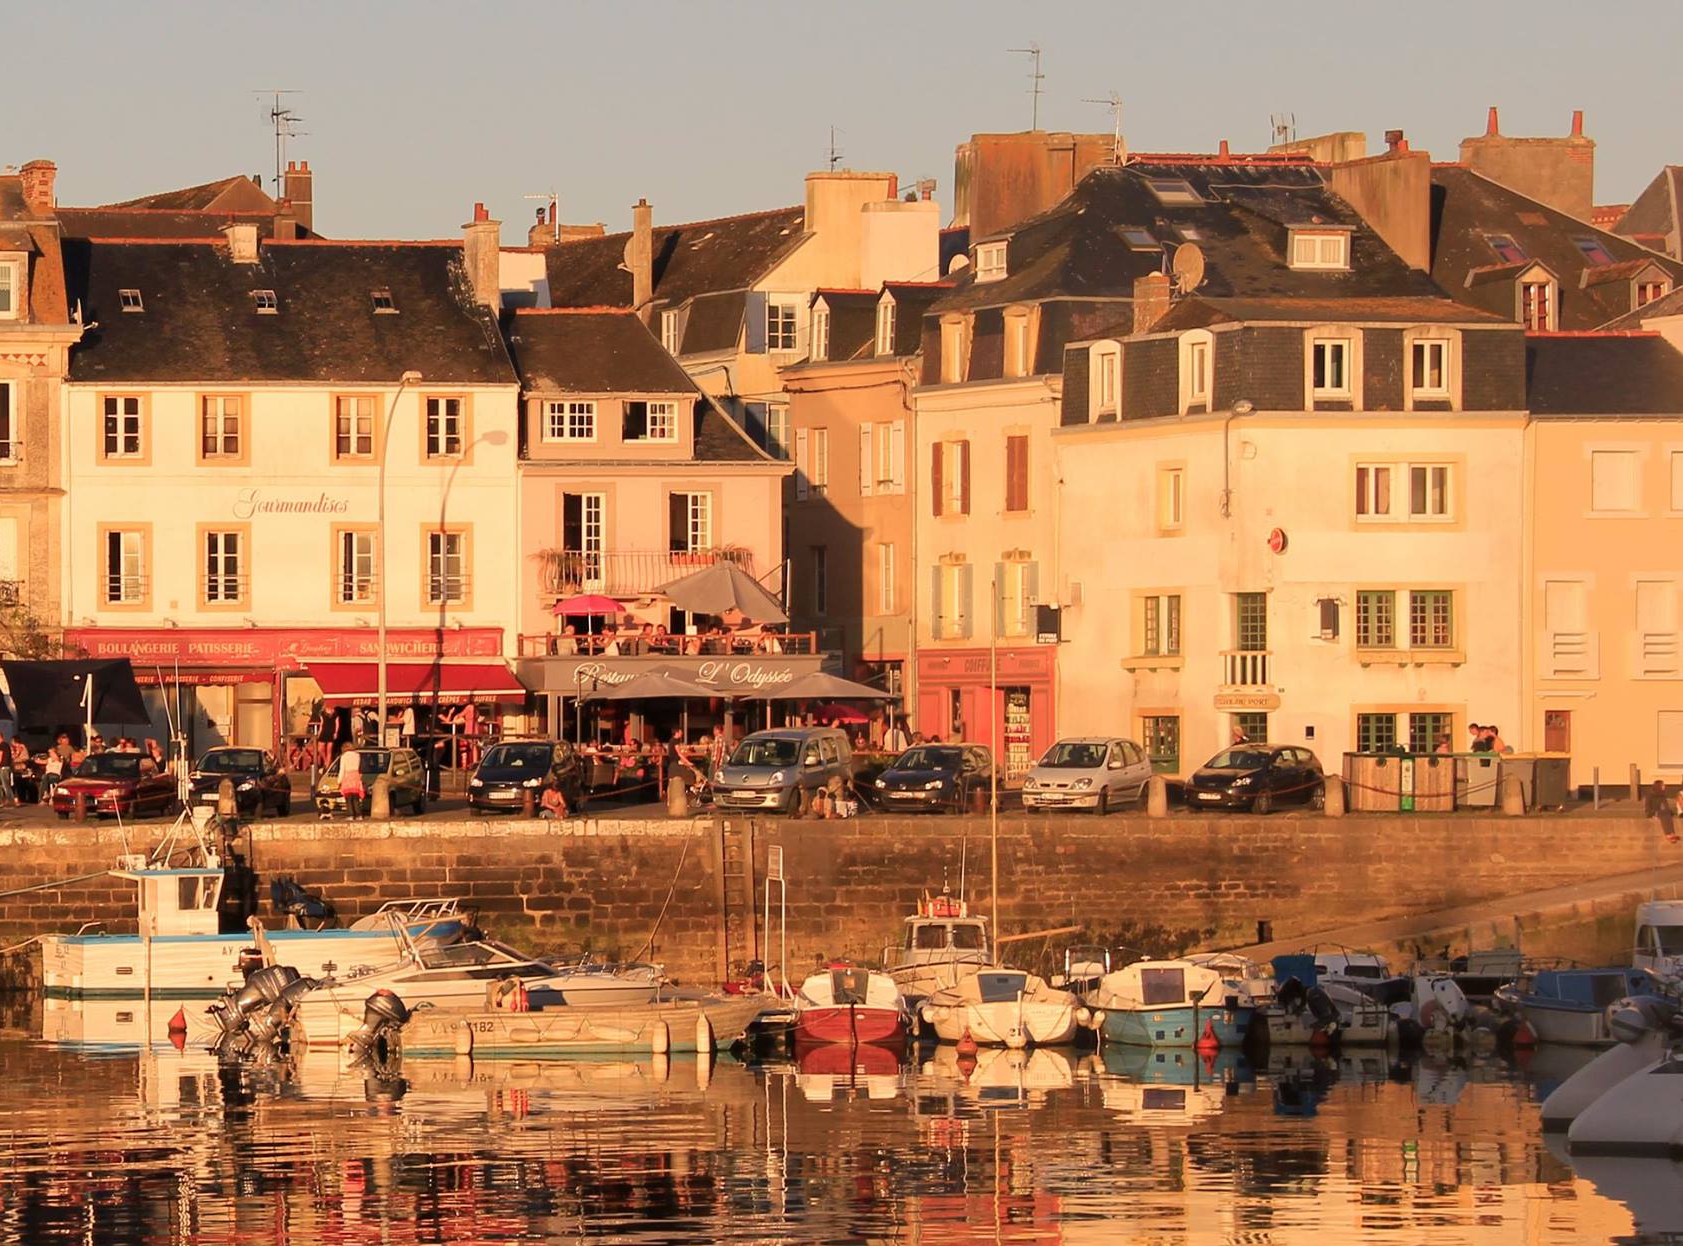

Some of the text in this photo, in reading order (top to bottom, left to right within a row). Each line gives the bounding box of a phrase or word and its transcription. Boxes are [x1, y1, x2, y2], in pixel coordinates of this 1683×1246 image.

[232, 488, 349, 519] Gourmandises
[98, 642, 255, 654] BOULANGERIE PATISSERIE
